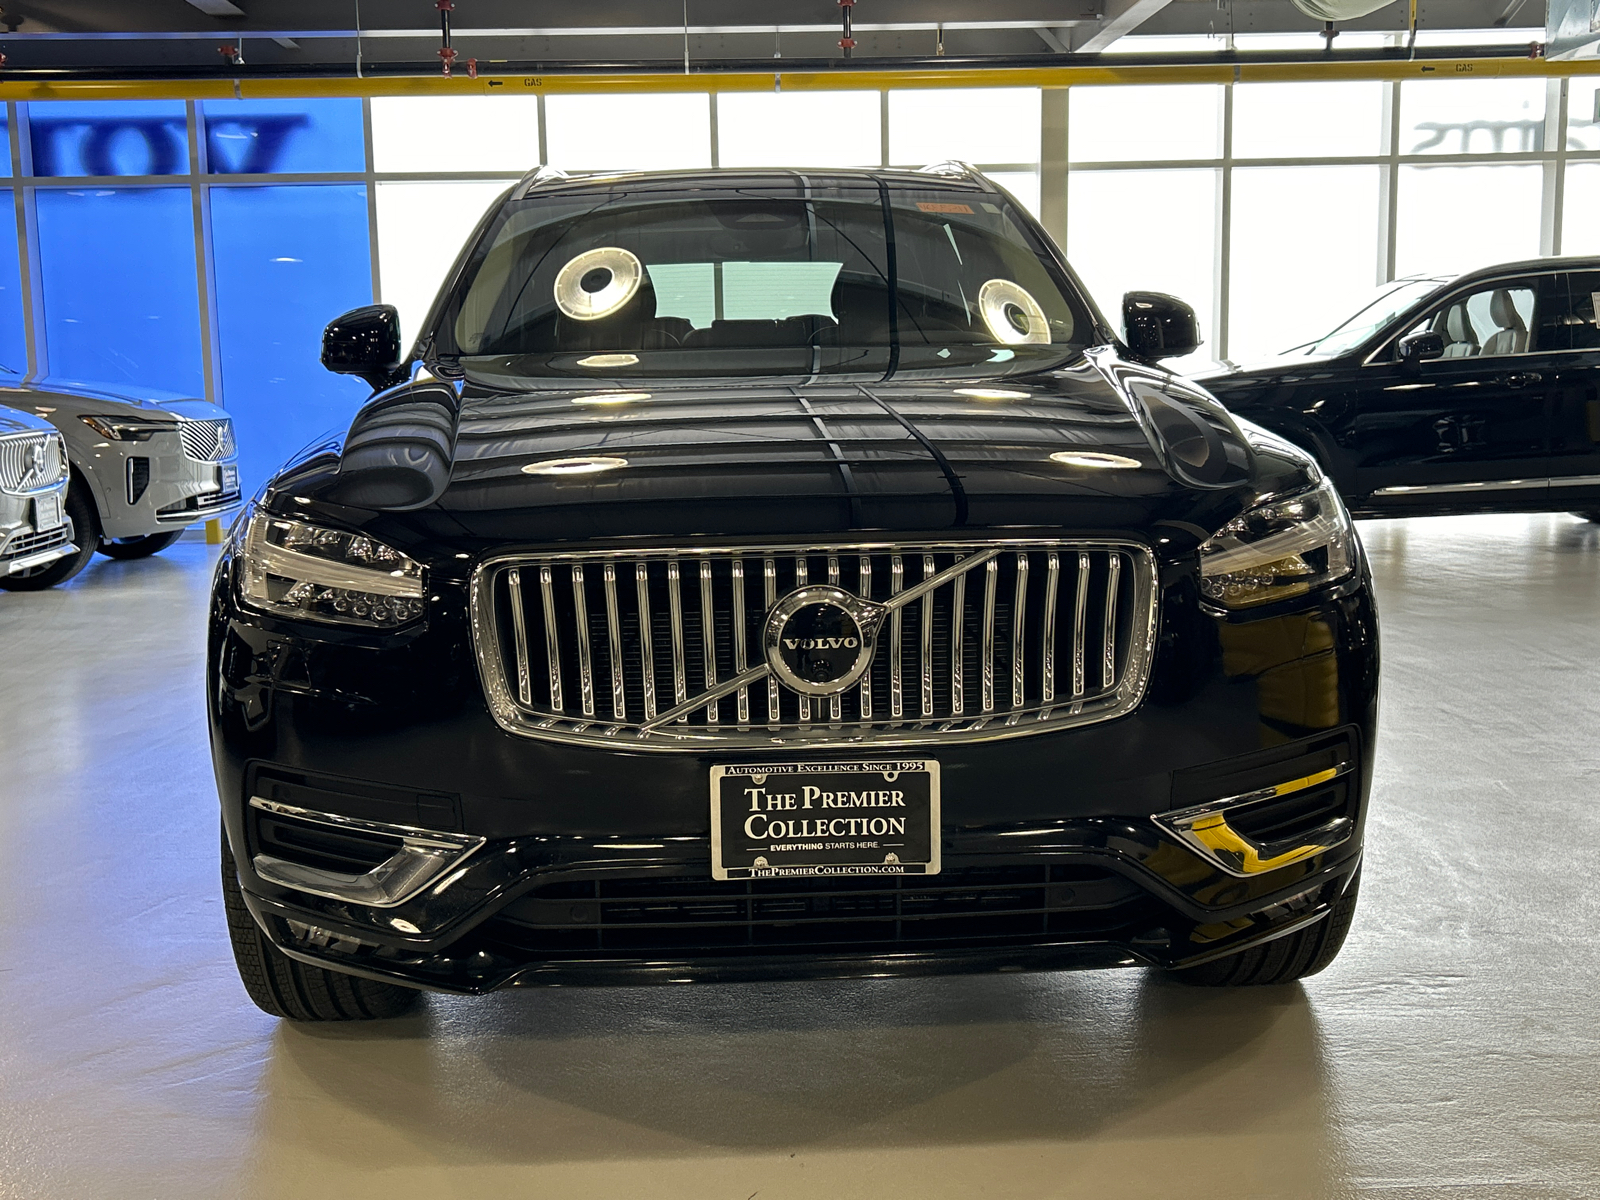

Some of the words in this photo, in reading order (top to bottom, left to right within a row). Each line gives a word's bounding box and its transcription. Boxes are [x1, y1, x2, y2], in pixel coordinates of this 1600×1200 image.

[1455, 63, 1473, 72] GAS
[524, 78, 542, 87] GAS
[783, 636, 858, 650] VOLVO
[728, 766, 794, 775] AUTOMOTIVE
[797, 764, 860, 773] EXCELLENCE
[862, 763, 893, 771] SINCE
[896, 761, 924, 771] 1995
[744, 787, 797, 812] THE
[801, 785, 906, 809] PREMIER
[744, 814, 906, 840] COLLECTION
[770, 843, 823, 852] EVERYTHING
[825, 842, 855, 850] STARTS
